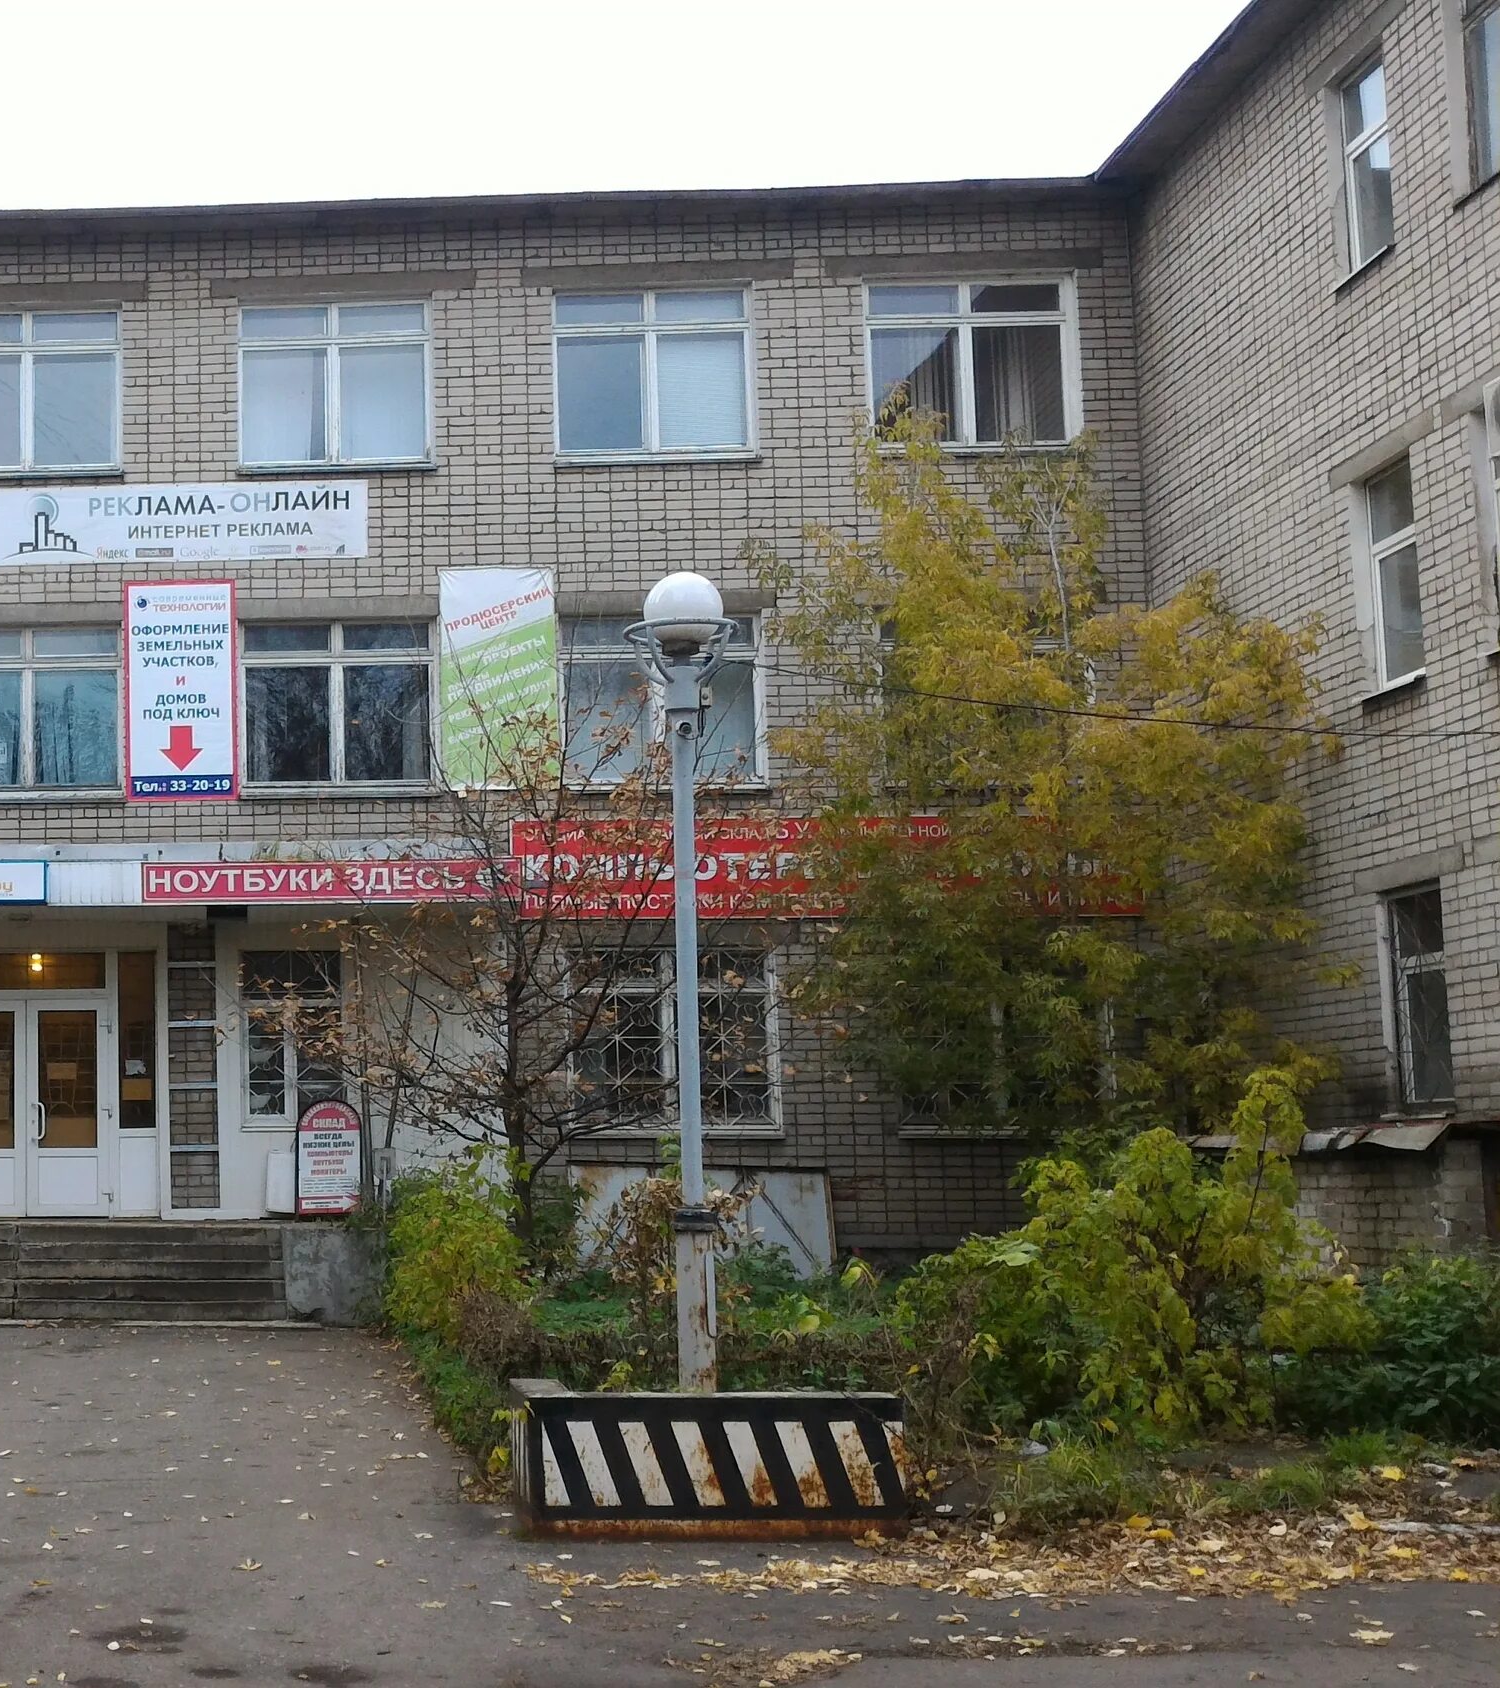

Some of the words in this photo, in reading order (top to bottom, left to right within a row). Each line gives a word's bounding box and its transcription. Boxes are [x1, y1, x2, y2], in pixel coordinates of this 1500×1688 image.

[127, 523, 219, 540] ИНТЕРНЕТ
[226, 521, 313, 538] РЕКЛАМА
[96, 547, 129, 560] Яндекс
[179, 546, 220, 559] Google
[445, 586, 551, 632] ПРОДЮСЕРСКИЙ
[479, 610, 518, 630] ЦЕНТР
[131, 623, 230, 636] ОФОРМЛЕНИЕ
[137, 639, 224, 652] ЗЕМЕЛЬНЫХ
[482, 635, 547, 666] ПРОЕКТЫ
[143, 655, 219, 668] УЧАСТКОВ,
[175, 676, 186, 686] И
[155, 693, 207, 706] ДОМОВ
[143, 709, 173, 720] ПОД
[177, 707, 220, 719] КЛЮЧ
[134, 780, 167, 792] Тел.:
[169, 779, 231, 791] 33-20-19
[150, 868, 333, 893] НОУТБУКИ
[345, 866, 466, 895] ЗДЕСЬ
